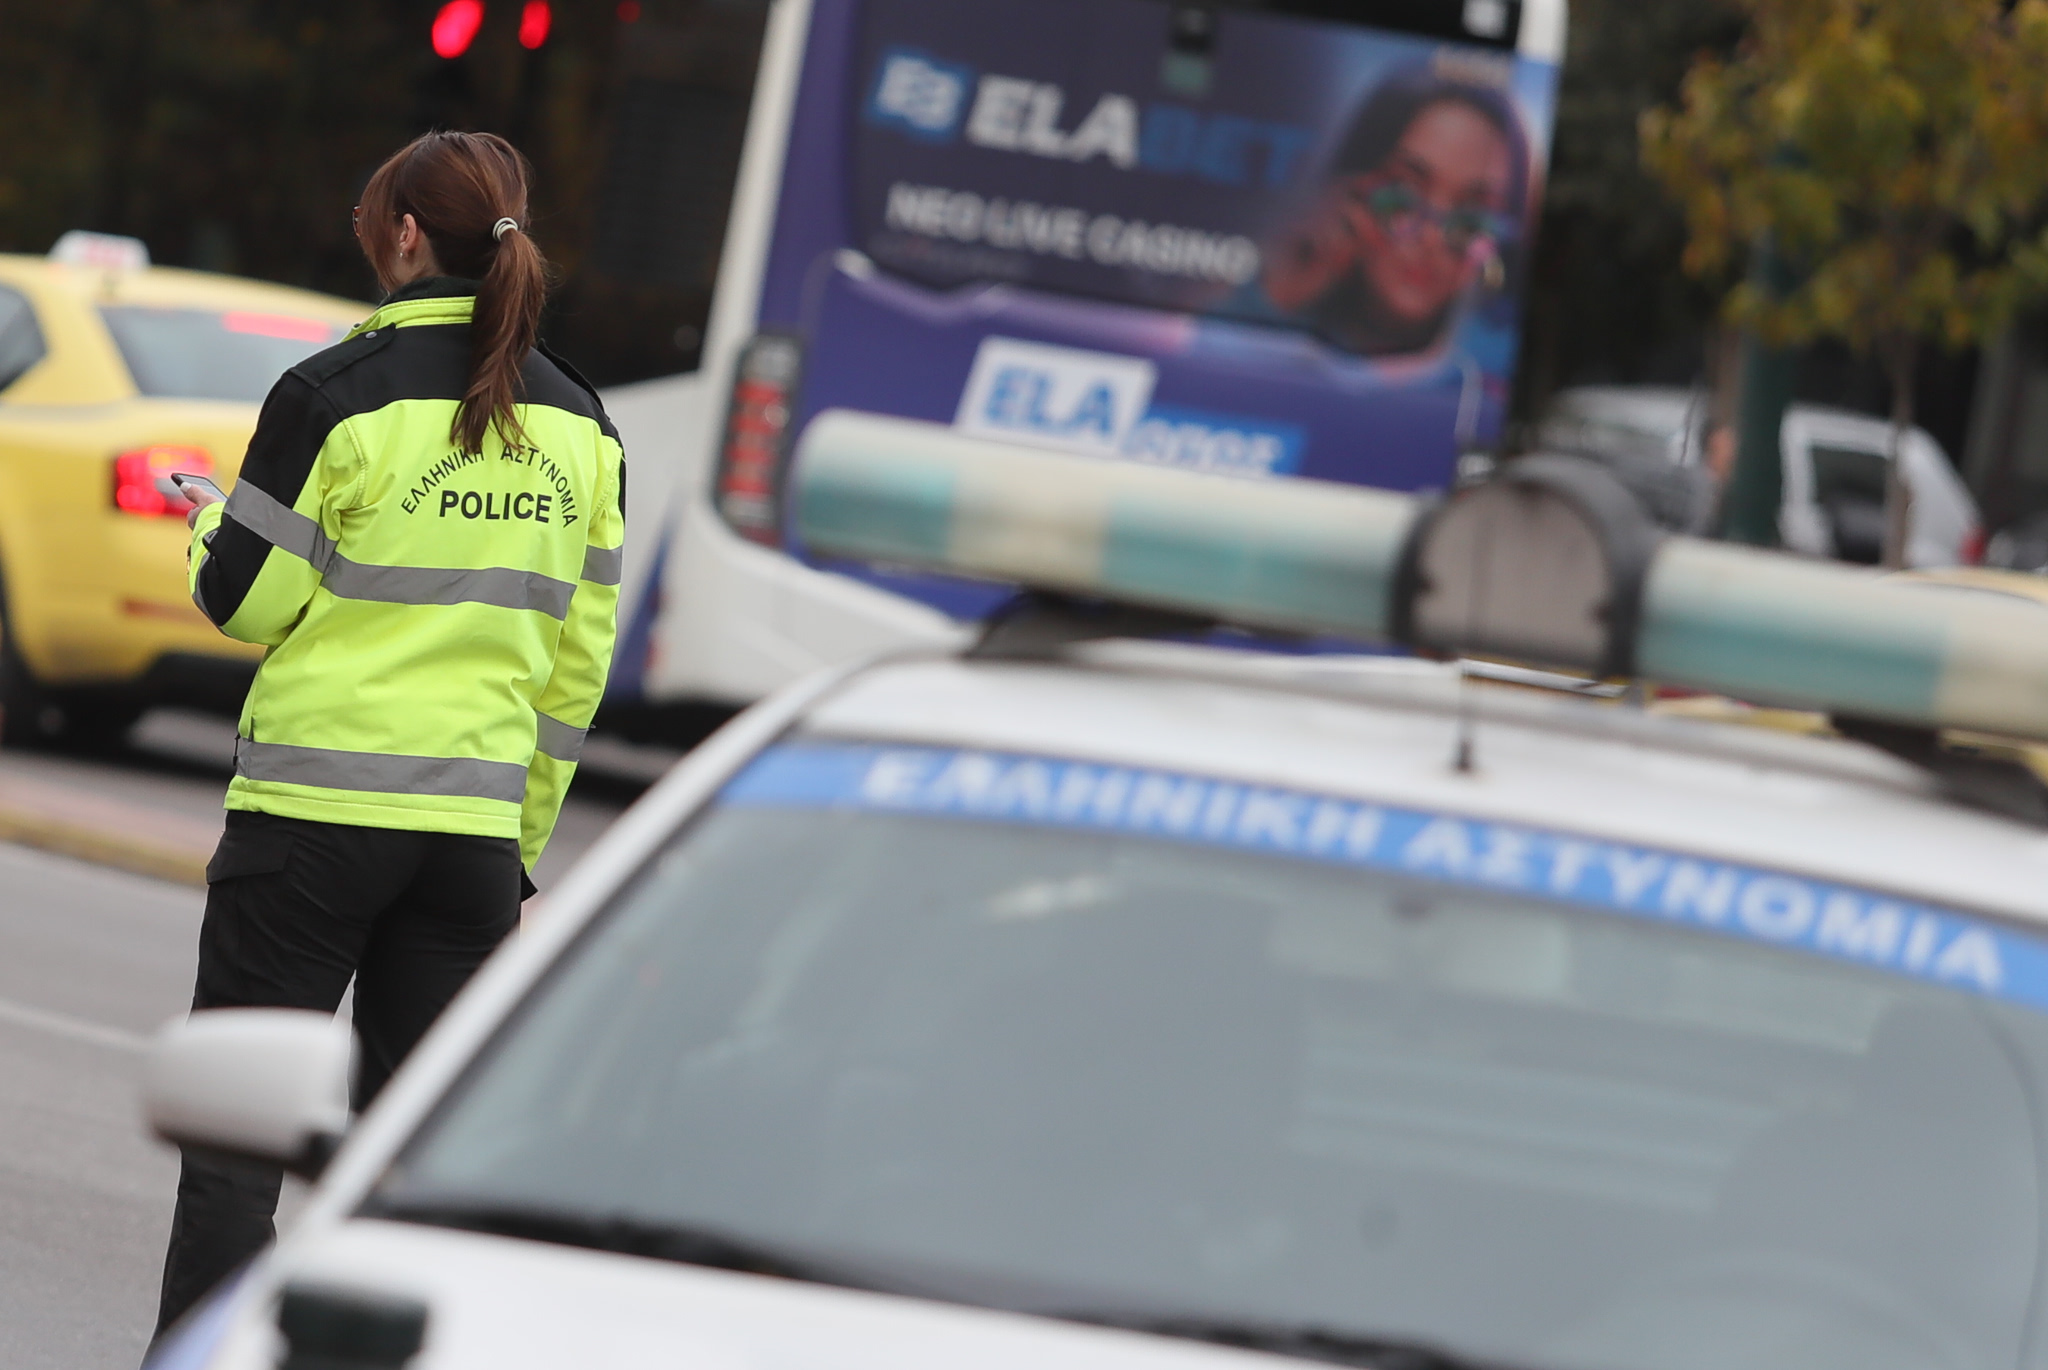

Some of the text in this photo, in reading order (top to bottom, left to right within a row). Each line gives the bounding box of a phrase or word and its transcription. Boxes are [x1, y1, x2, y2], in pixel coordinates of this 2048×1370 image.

[986, 198, 1088, 260] LIVE
[1088, 213, 1261, 285] CASINO
[439, 490, 552, 524] POLICE
[500, 443, 578, 528] ΑΣΤΥΝΟΜΙΑ
[864, 750, 2004, 992] ΕΛΛΗΝΙΚΗ ΑΣΤΥΝΟΜΙΑ
